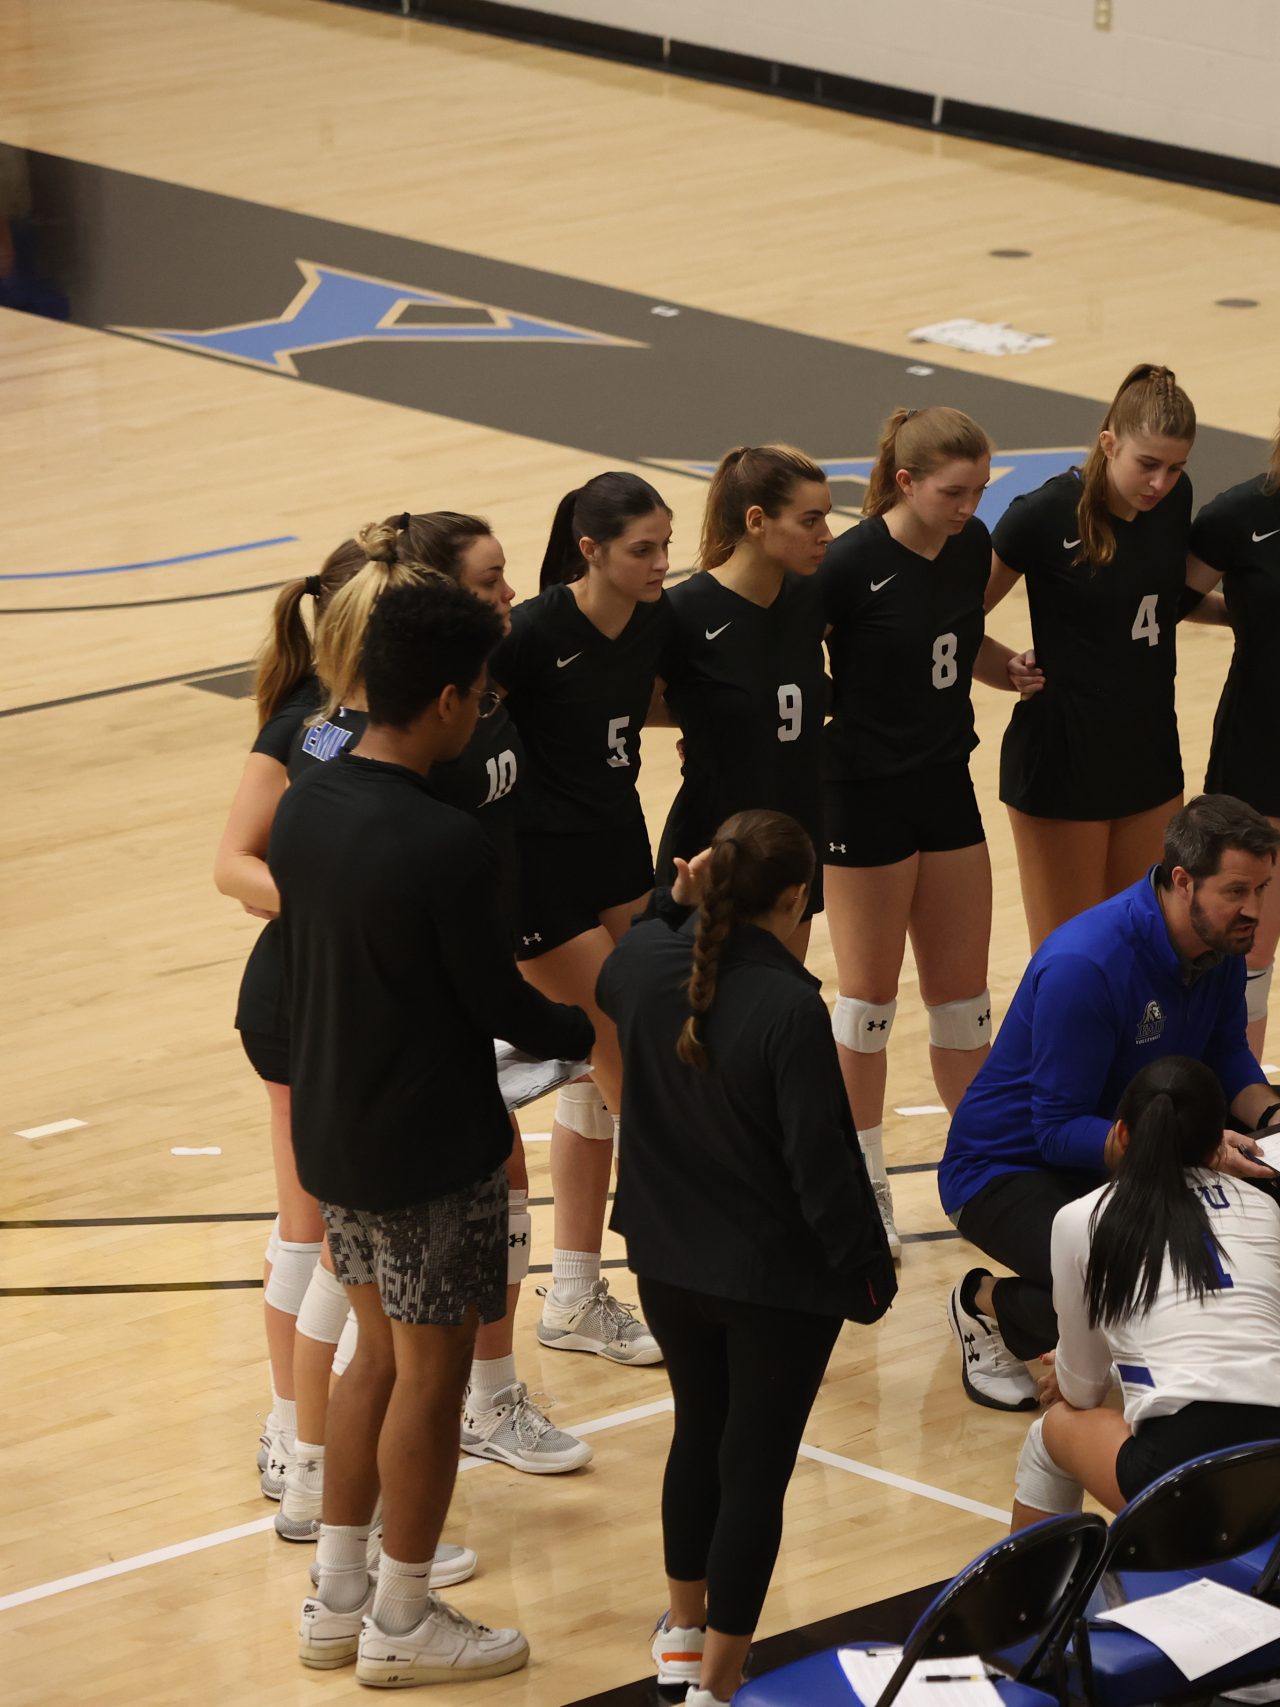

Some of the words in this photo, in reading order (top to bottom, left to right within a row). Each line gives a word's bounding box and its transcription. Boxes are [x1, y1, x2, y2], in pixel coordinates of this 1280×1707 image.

[1131, 593, 1161, 647] 4
[931, 632, 958, 690] 8
[606, 715, 631, 768] 5
[777, 683, 803, 743] 9
[474, 749, 518, 809] 10
